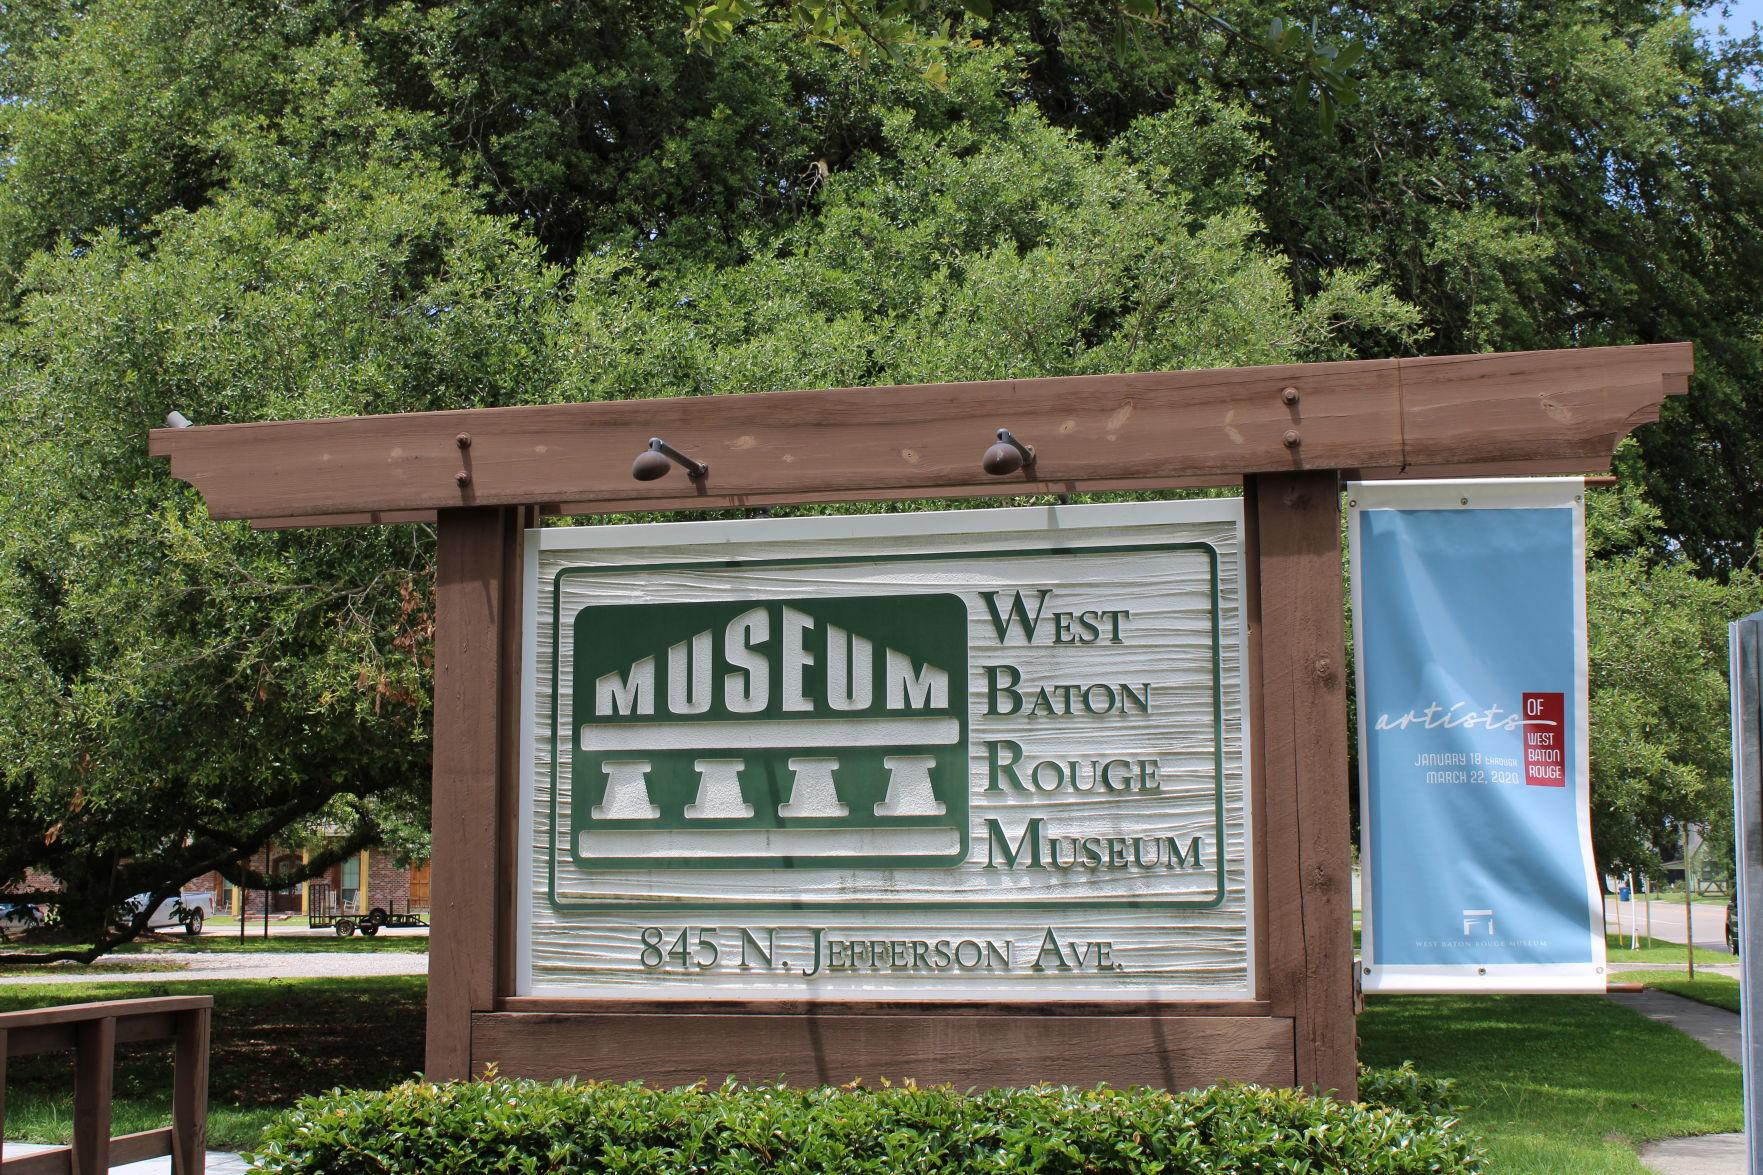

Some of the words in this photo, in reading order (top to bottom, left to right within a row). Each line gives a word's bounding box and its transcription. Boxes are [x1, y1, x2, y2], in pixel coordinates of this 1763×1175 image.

[978, 588, 1130, 645] WEST
[595, 604, 949, 716] MUSEUM
[982, 664, 1152, 716] BATON
[1375, 701, 1557, 730] artists
[1527, 698, 1544, 716] OF
[1527, 732, 1555, 746] WEST
[983, 739, 1161, 792] ROUGE
[1415, 753, 1466, 767] JANUARY
[1470, 752, 1482, 765] 18
[1528, 749, 1560, 762] BATON
[1426, 771, 1467, 784] MARCH
[1470, 771, 1488, 785] 22,
[1491, 771, 1519, 785] 2020
[1529, 765, 1562, 779] ROUGE
[983, 817, 1204, 870] MUSEUM
[641, 926, 719, 968] 845
[738, 927, 789, 968] N.
[803, 927, 1013, 977] JEFFERSON
[1030, 925, 1123, 971] AVE.
[1415, 940, 1438, 948] WEST
